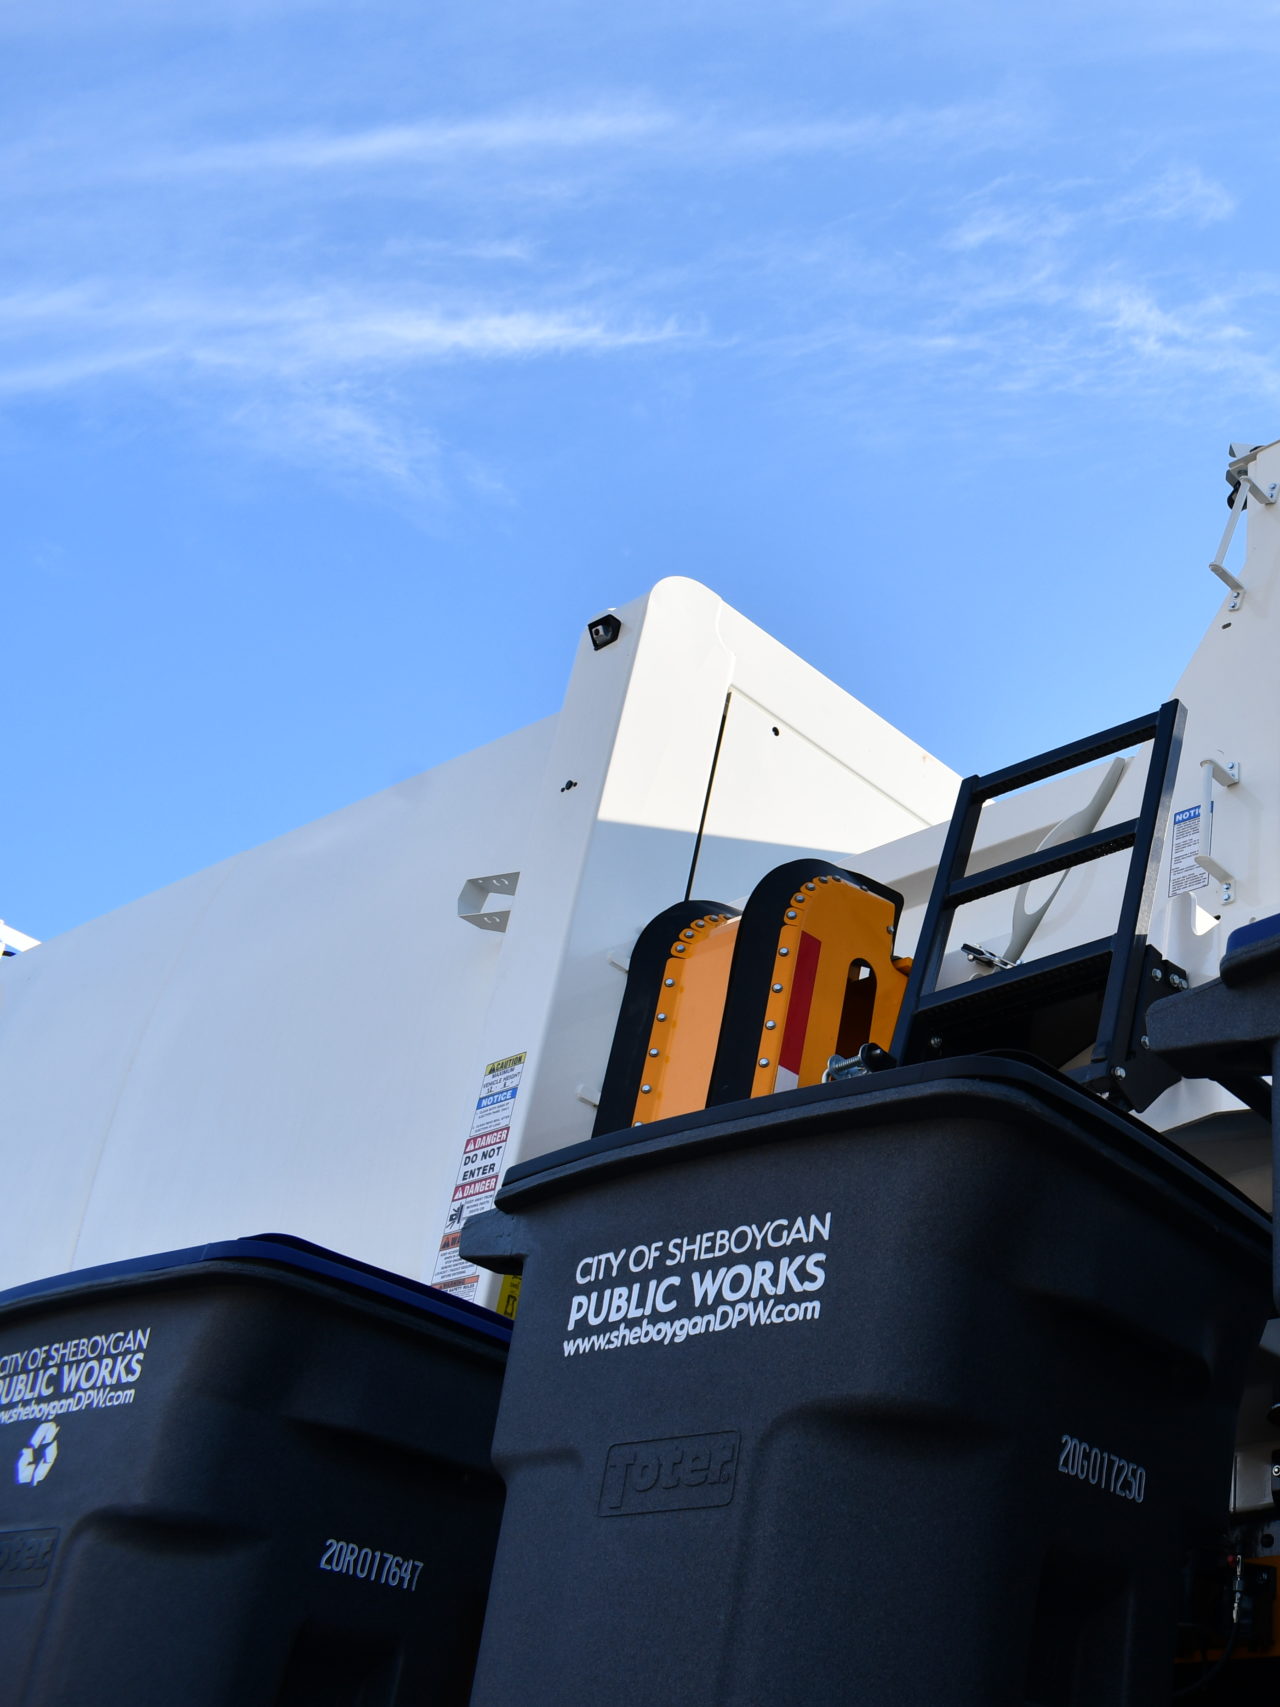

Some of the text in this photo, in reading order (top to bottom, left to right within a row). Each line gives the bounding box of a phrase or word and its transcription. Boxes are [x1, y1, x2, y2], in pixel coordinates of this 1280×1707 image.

[1176, 808, 1201, 822] NOTI
[495, 1055, 523, 1073] CAUTION
[481, 1090, 512, 1108] NOTICE
[475, 1129, 508, 1149] DANGER
[462, 1163, 496, 1180] ENTER
[463, 1146, 502, 1166] DO NOT
[463, 1178, 496, 1197] DANGER
[575, 1212, 832, 1285] CITY OF SHEBOYGAN
[567, 1252, 827, 1331] PUBLIC WORKS
[562, 1299, 821, 1357] www.sheboyganDPW.com
[0, 1327, 151, 1378] CITY OF SHEBOYGAN
[62, 1352, 145, 1394] WORKS
[1058, 1434, 1146, 1504] 20G017250
[319, 1538, 424, 1592] 20R017647
